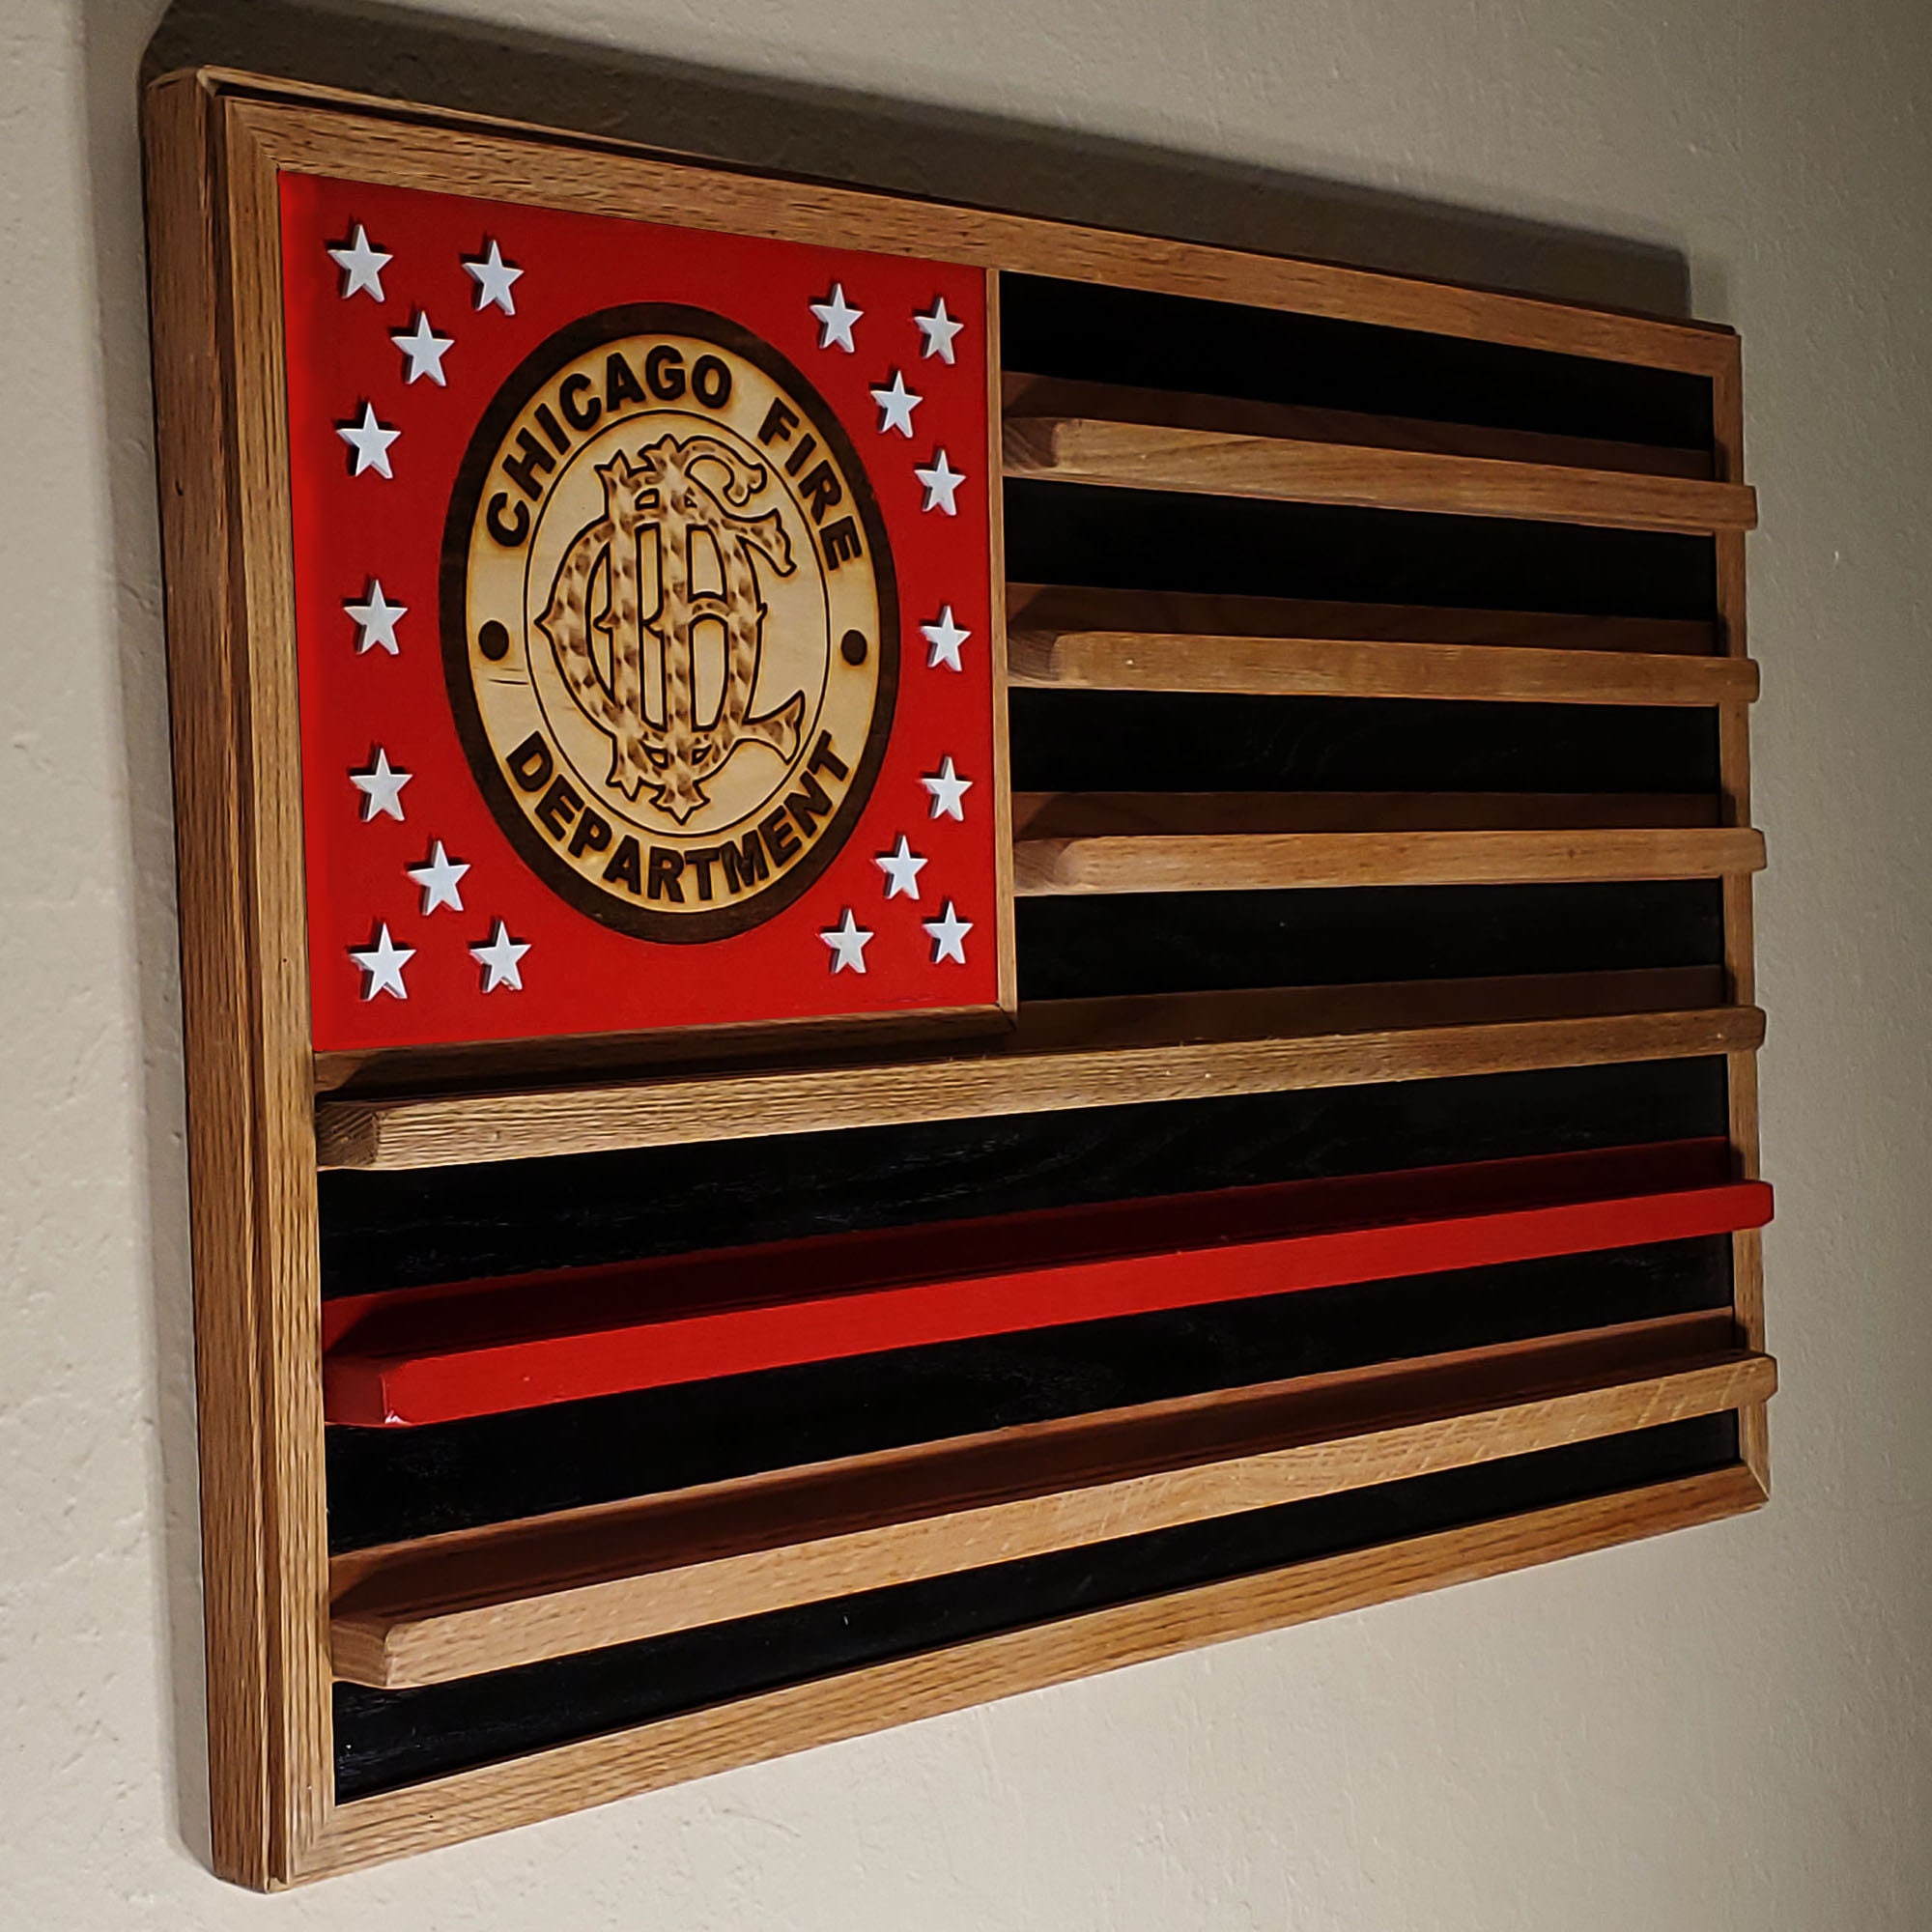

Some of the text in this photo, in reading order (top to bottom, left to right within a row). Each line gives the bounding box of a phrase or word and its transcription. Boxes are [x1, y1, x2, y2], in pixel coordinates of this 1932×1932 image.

[486, 345, 863, 570] CHICAGO FIRE
[506, 729, 850, 903] DEPARTMENT
